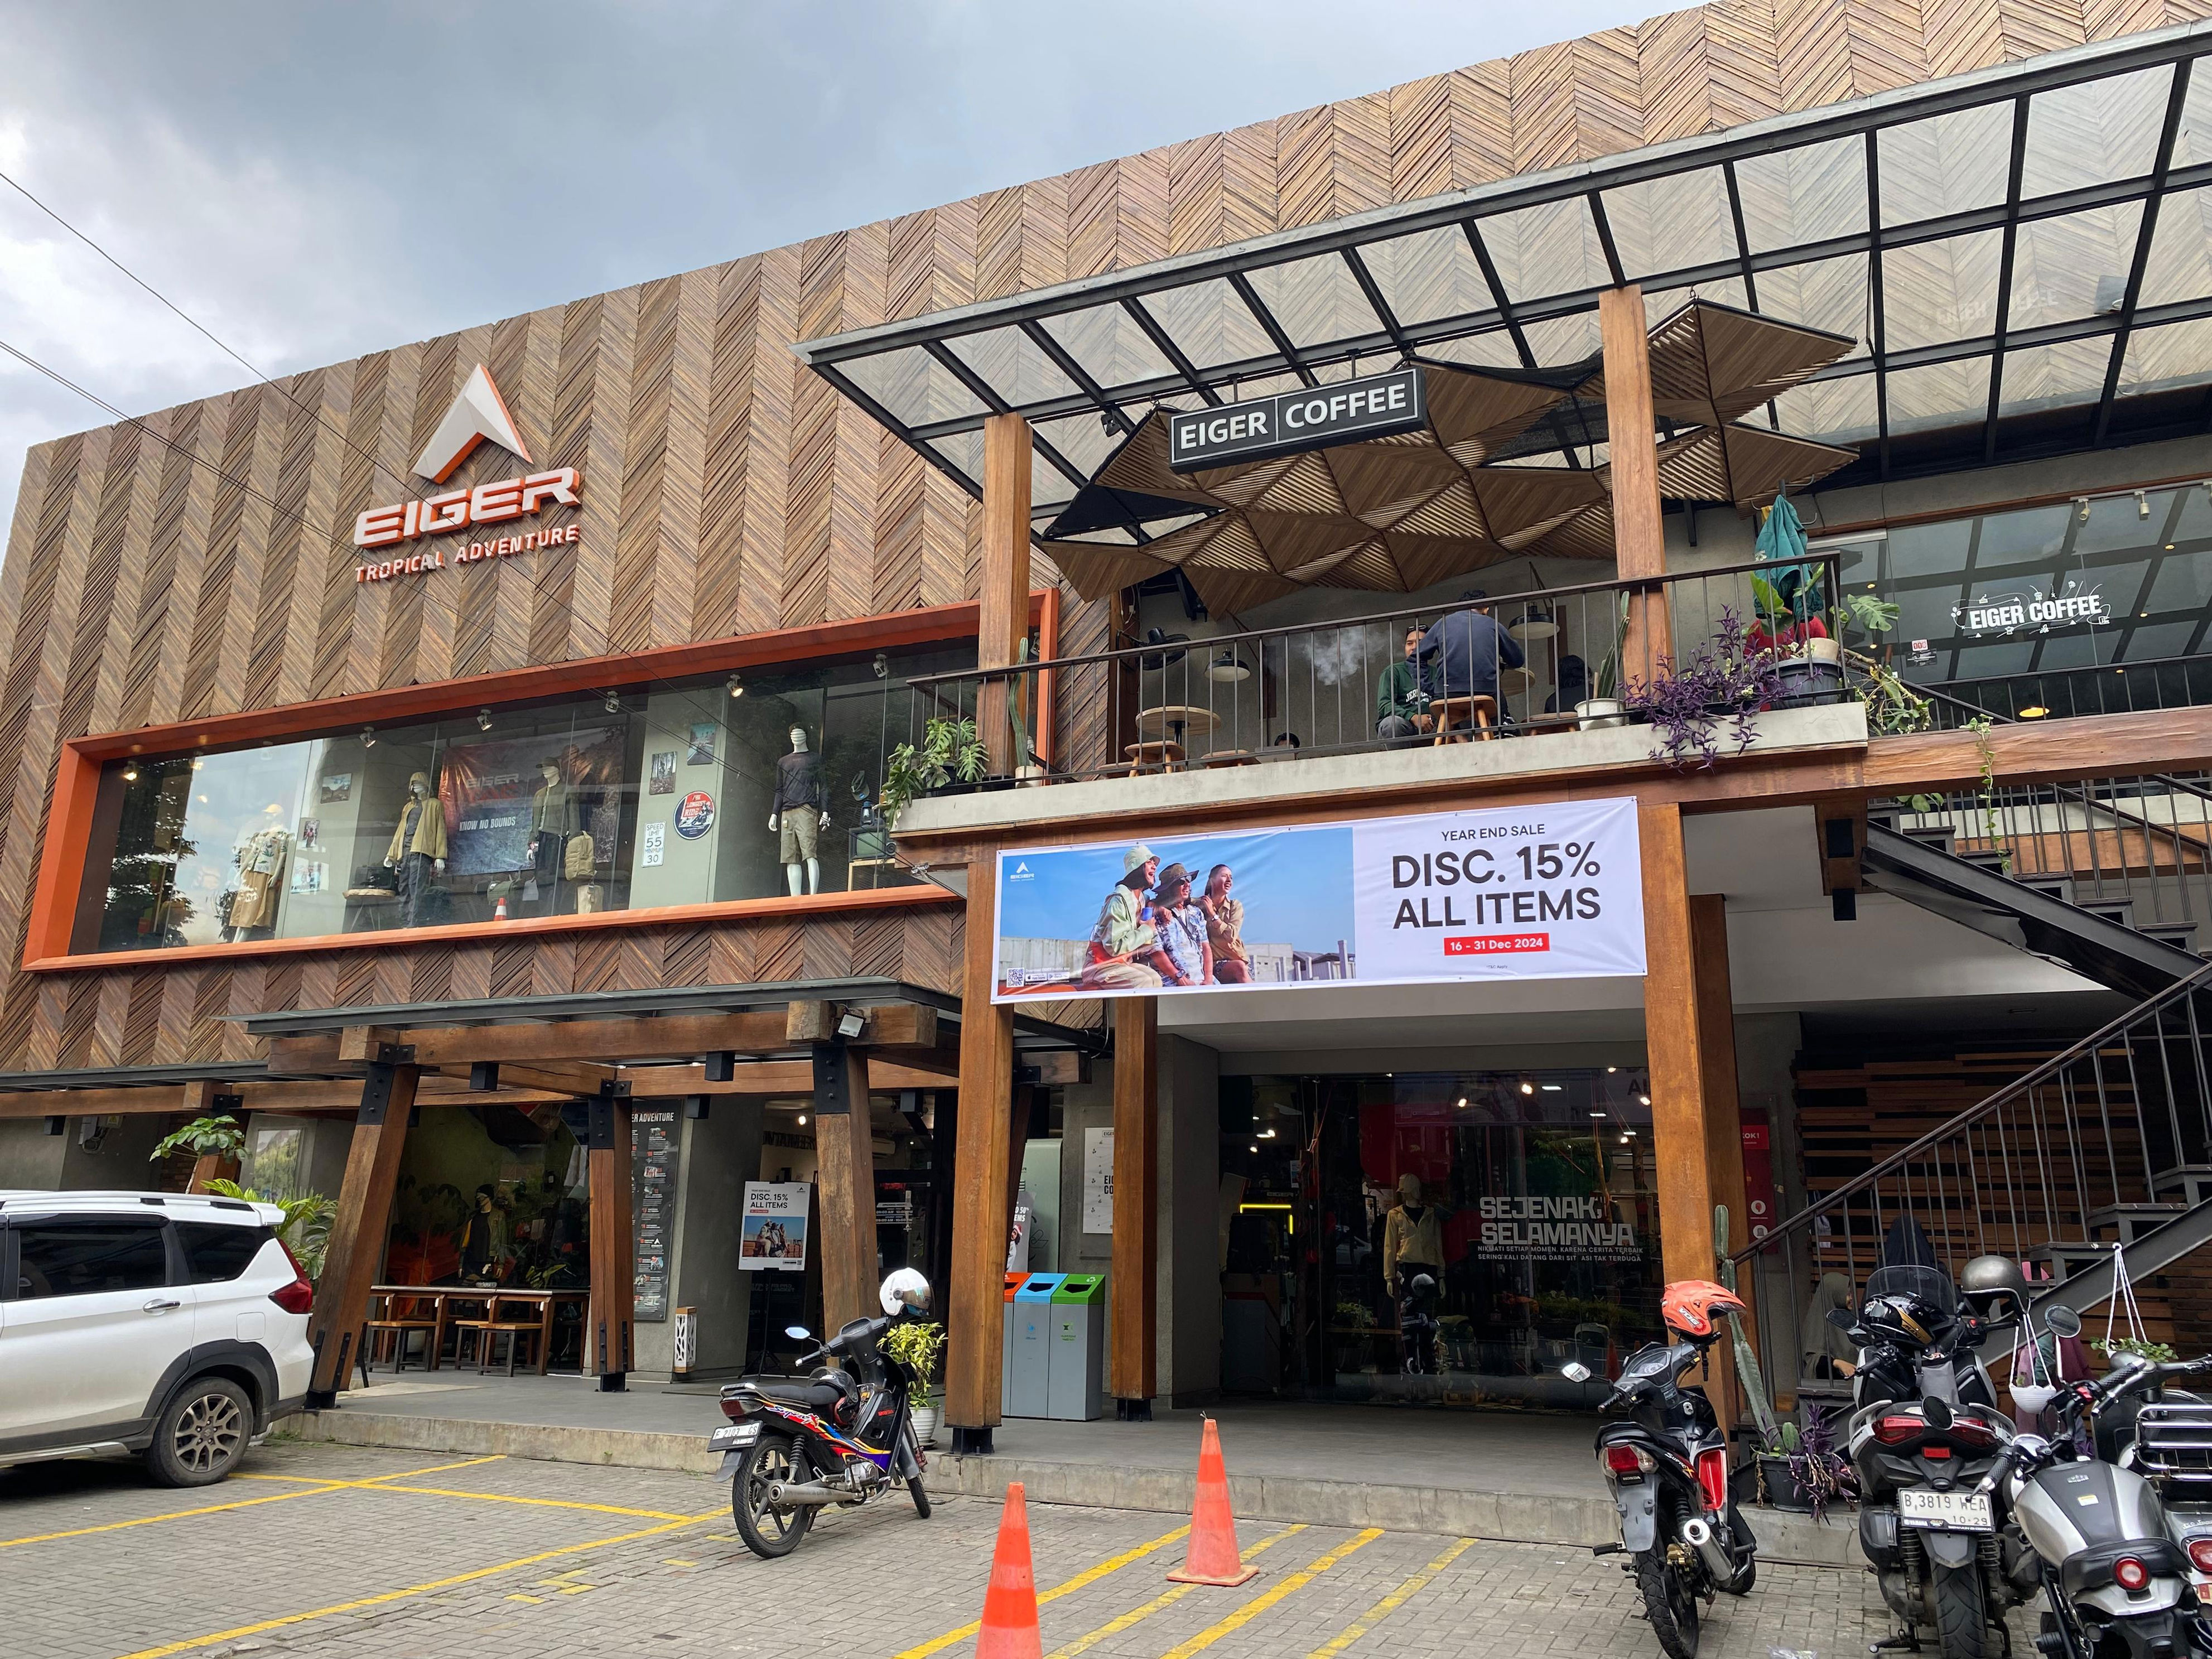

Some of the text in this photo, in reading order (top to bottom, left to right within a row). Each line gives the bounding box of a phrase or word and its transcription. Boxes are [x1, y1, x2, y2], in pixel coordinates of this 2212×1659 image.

[1181, 383, 1406, 450] EIGER COFFEE
[354, 467, 581, 548] EIGER
[355, 524, 580, 583] TROPICAL ADVENTURE
[1969, 595, 2102, 629] EIGER COFFEE
[459, 816, 516, 831] KNOW NO BOUNDS
[1442, 823, 1545, 842] YEAR END SALE
[646, 837, 662, 848] 55
[647, 855, 658, 863] 30
[1392, 841, 1601, 888] DISC. 15%
[1392, 887, 1601, 929] ALL ITEMS
[1450, 941, 1462, 952] 16
[1473, 940, 1486, 950] 31
[1489, 938, 1512, 950] Dec
[1515, 937, 1543, 948] 2024
[639, 1112, 674, 1122] ADVENTURE
[1481, 1223, 1634, 1246] SELAMANYA
[748, 1426, 757, 1434] GS
[1904, 1494, 1912, 1507] B
[1919, 1495, 1951, 1508] 3819
